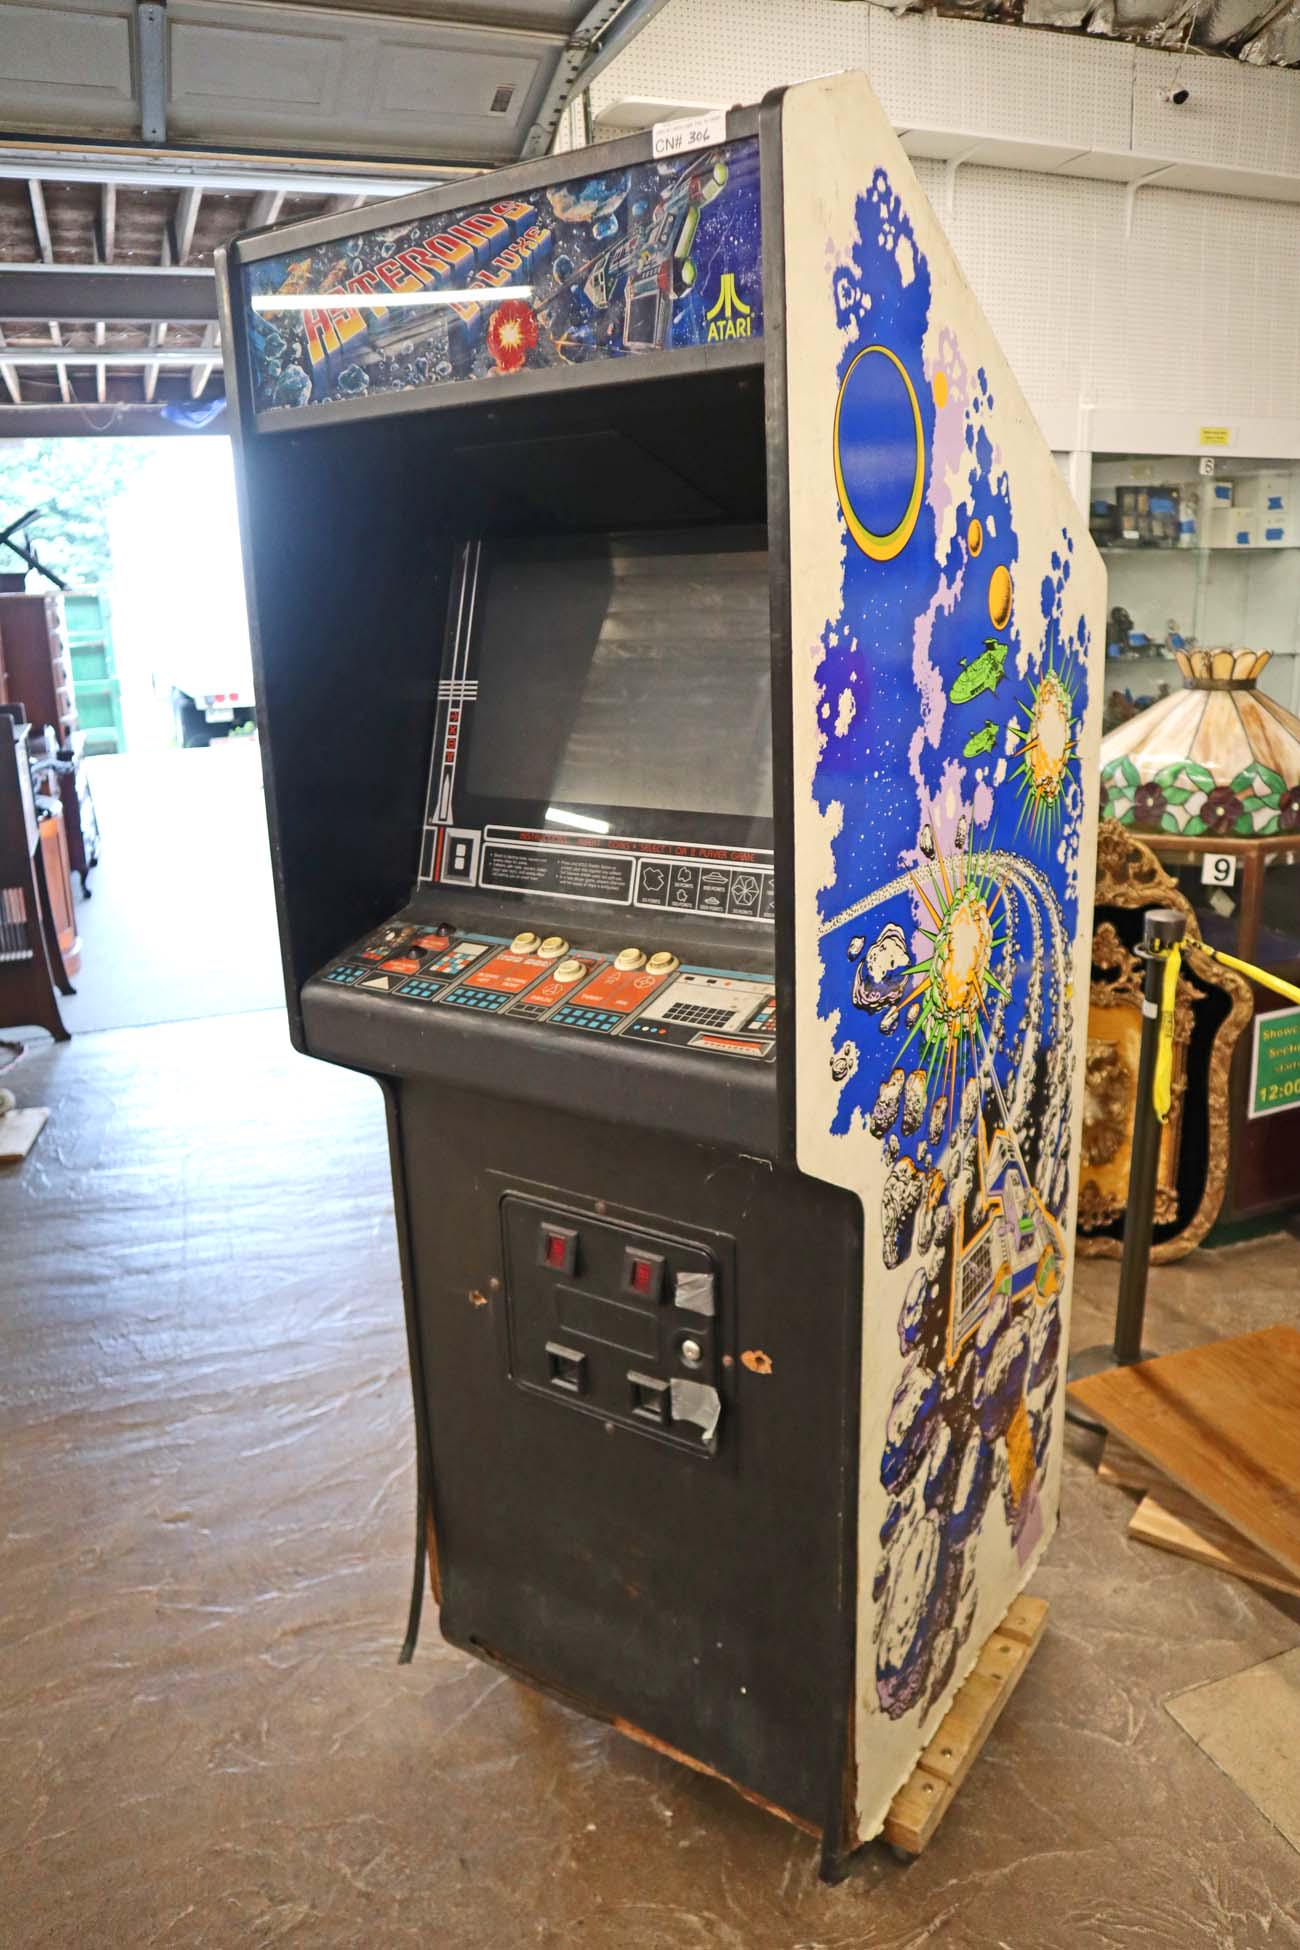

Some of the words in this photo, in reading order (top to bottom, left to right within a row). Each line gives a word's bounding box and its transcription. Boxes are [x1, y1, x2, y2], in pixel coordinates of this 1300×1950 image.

[655, 134, 683, 153] CN#
[302, 200, 535, 367] ASTEROIDS
[707, 316, 751, 342] ATARI
[1214, 858, 1230, 881] 9
